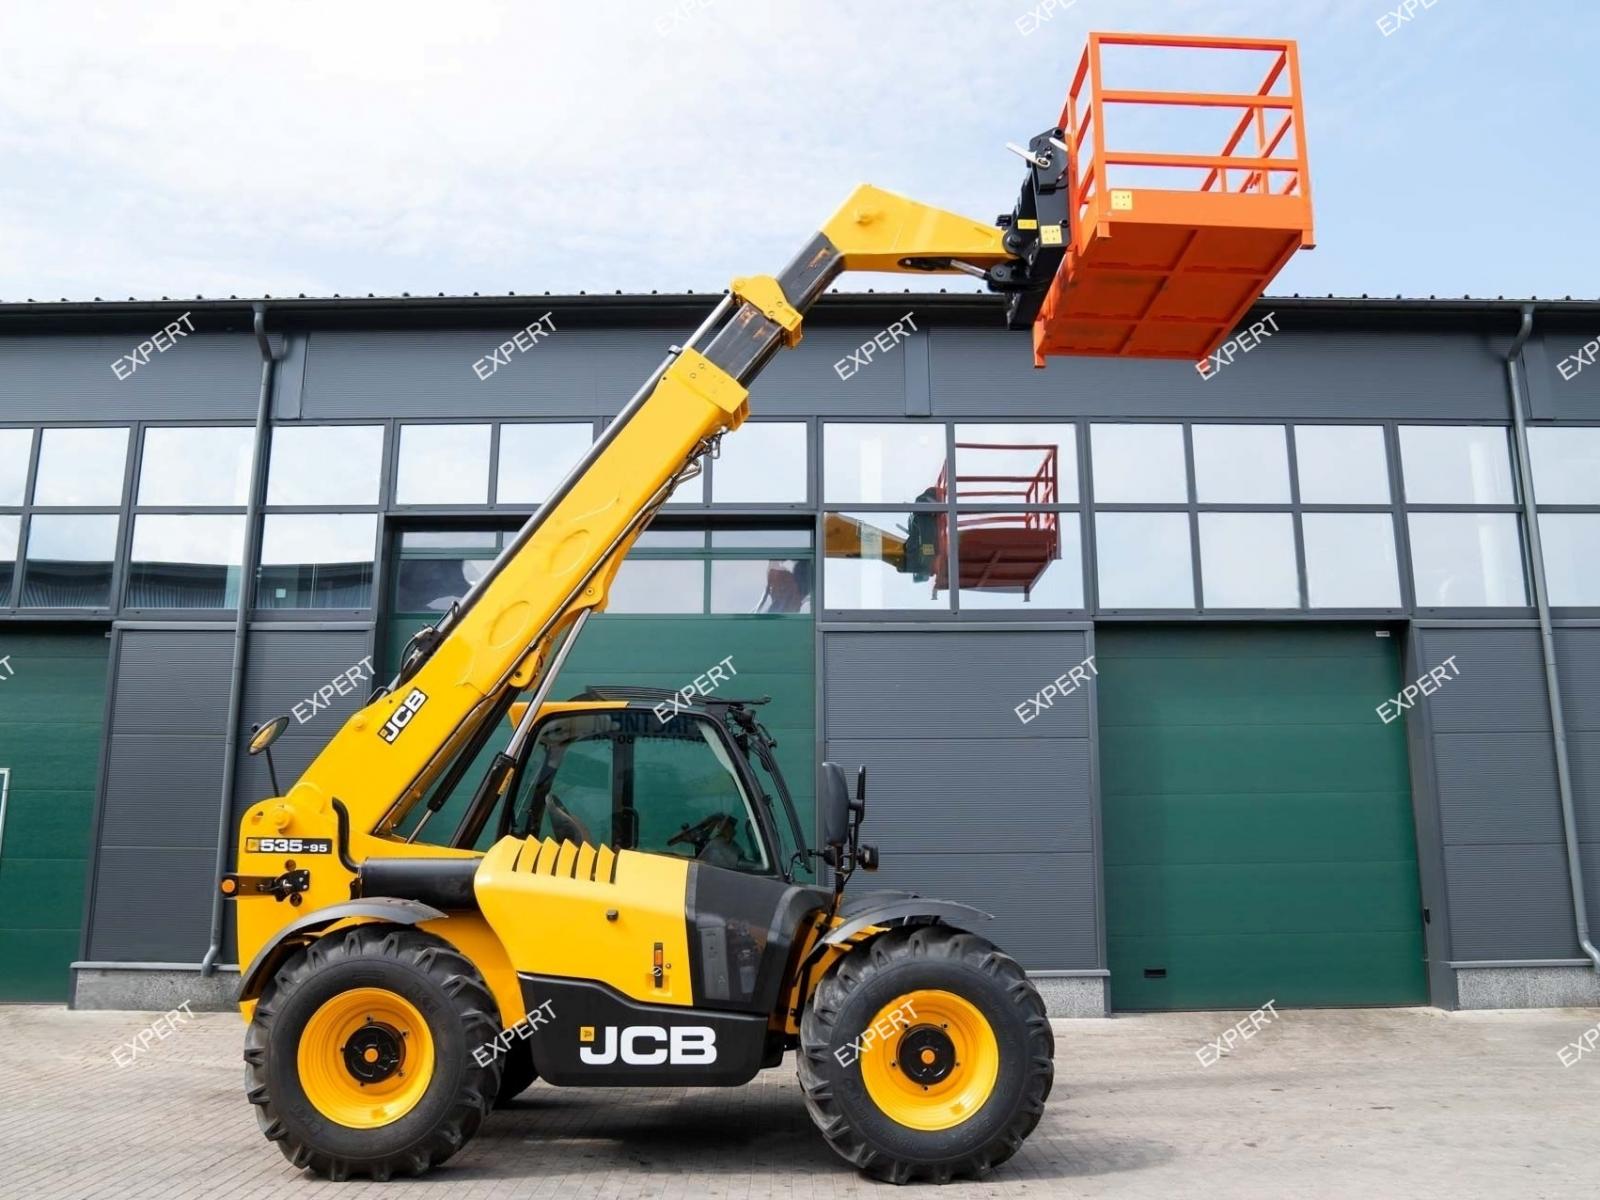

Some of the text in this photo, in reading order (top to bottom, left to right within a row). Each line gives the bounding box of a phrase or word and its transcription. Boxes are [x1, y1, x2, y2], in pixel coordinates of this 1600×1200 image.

[383, 689, 427, 742] JCB
[259, 838, 328, 853] 535-95
[579, 1025, 718, 1065] JCB
